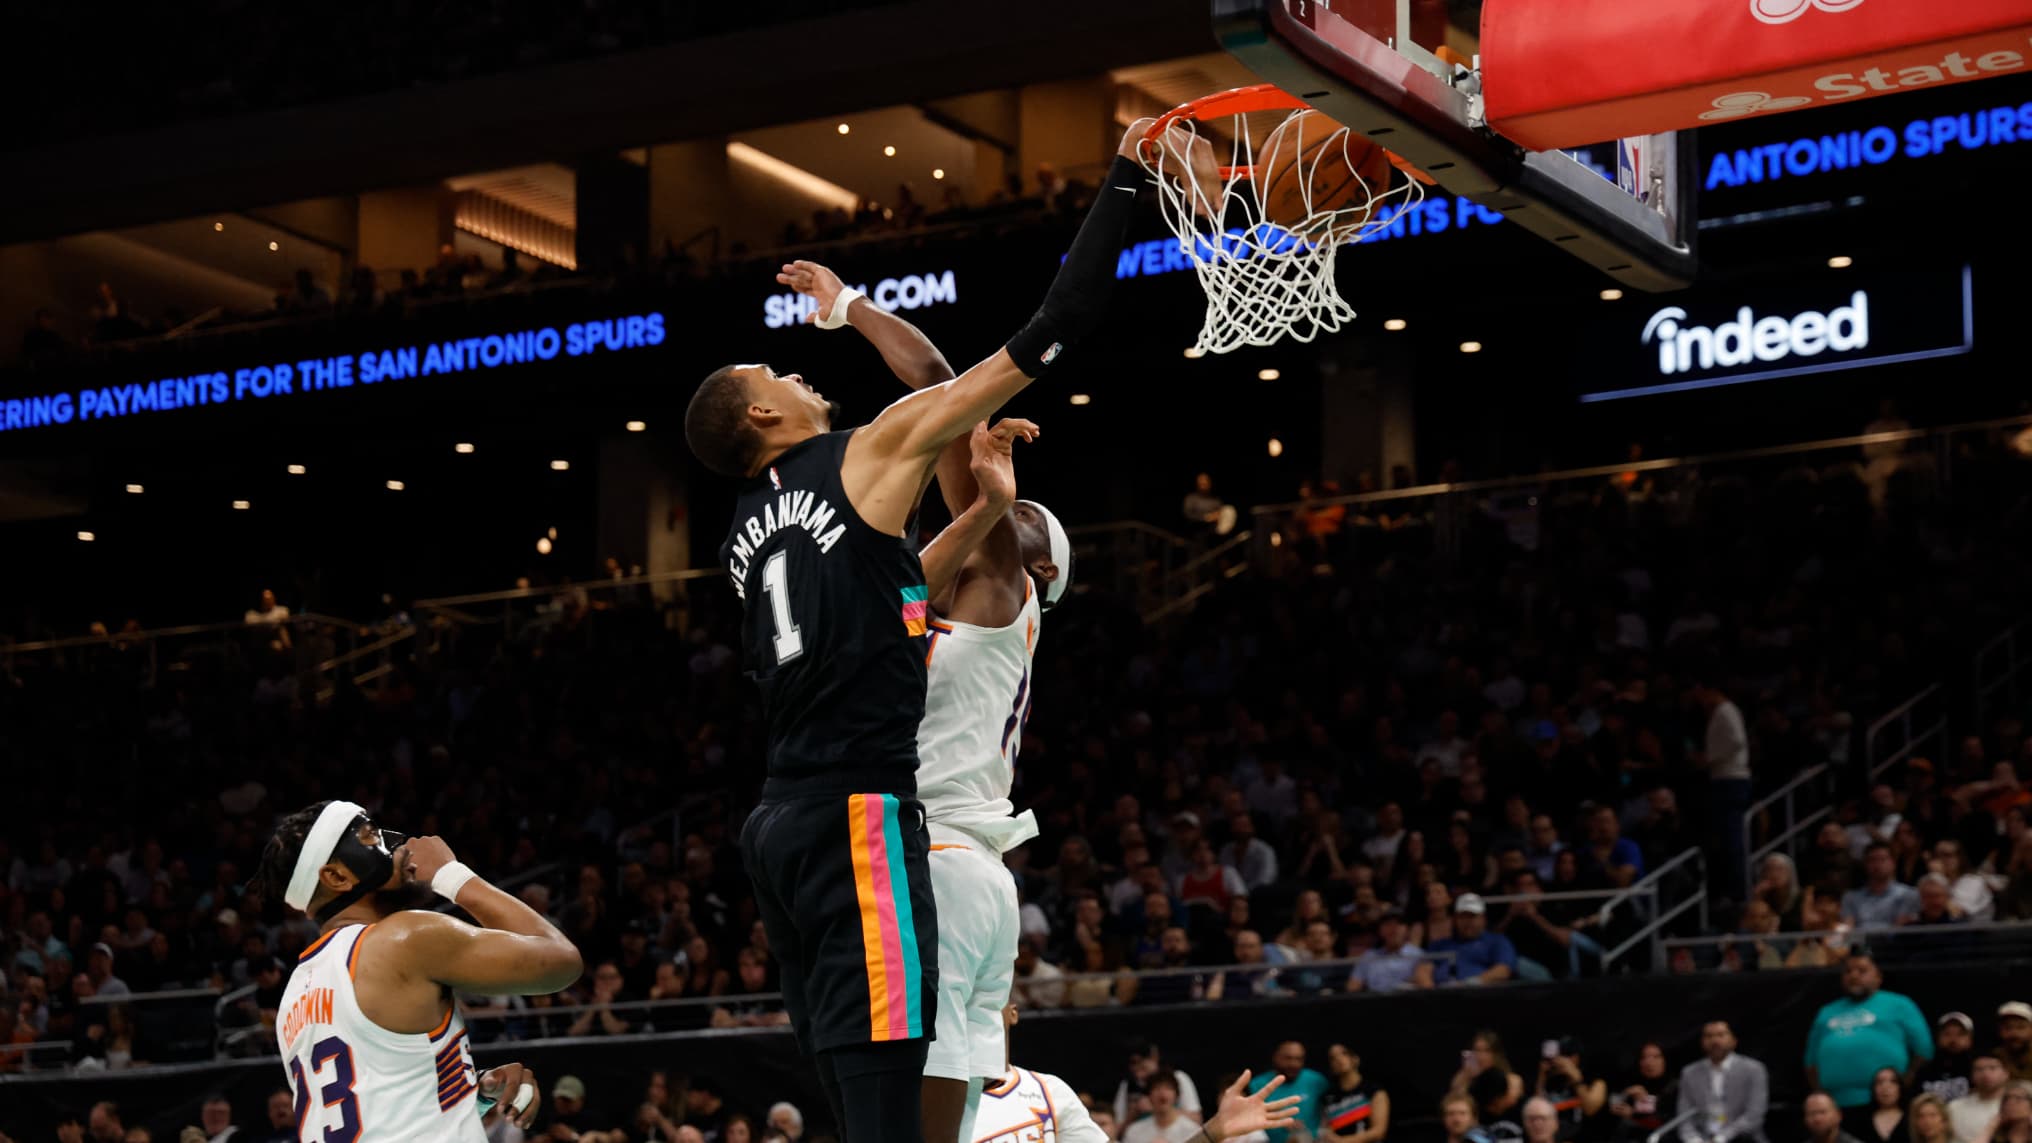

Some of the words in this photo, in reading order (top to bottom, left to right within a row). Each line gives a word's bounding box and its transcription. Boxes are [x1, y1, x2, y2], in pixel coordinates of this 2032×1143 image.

[1813, 50, 2025, 100] State
[1705, 125, 1898, 190] ANTONIO
[79, 371, 230, 421] PAYMENTS
[234, 363, 294, 401] FOR
[297, 354, 355, 392] THE
[358, 346, 418, 384] SAN
[421, 327, 562, 376] ANTONIO
[565, 312, 666, 356] SPURS
[1642, 290, 1869, 374] indeed
[729, 489, 847, 600] WEMBANYAMA
[763, 549, 803, 666] 1
[282, 987, 335, 1049] GOODWIN
